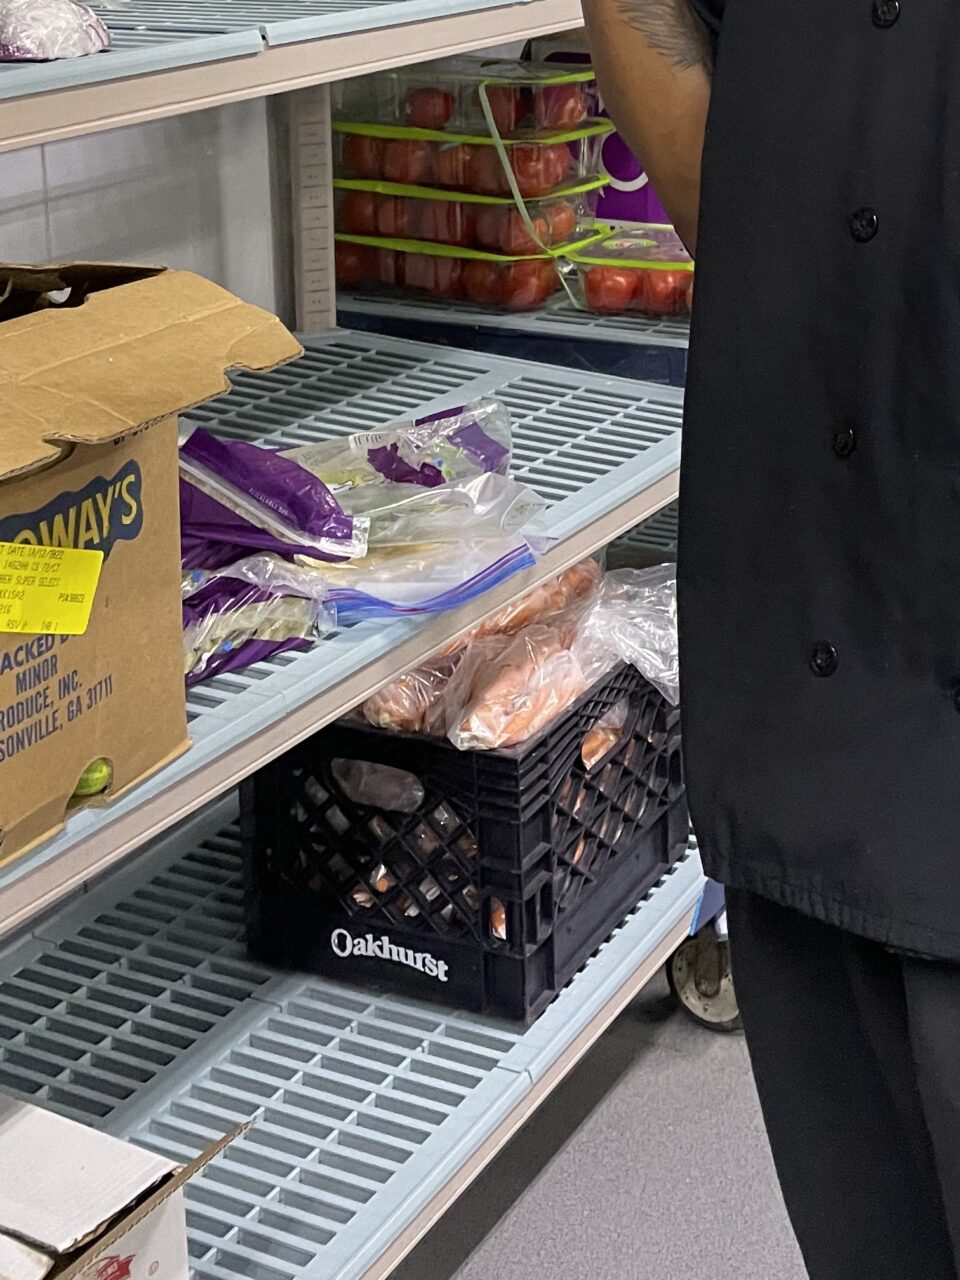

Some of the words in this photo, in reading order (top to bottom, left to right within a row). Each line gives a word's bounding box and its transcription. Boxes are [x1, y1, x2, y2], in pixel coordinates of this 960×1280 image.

[15, 654, 58, 696] MINOR
[58, 669, 82, 701] INC.
[67, 695, 82, 722] GA
[86, 673, 113, 710] 31711
[331, 928, 449, 982] Oakhurst
